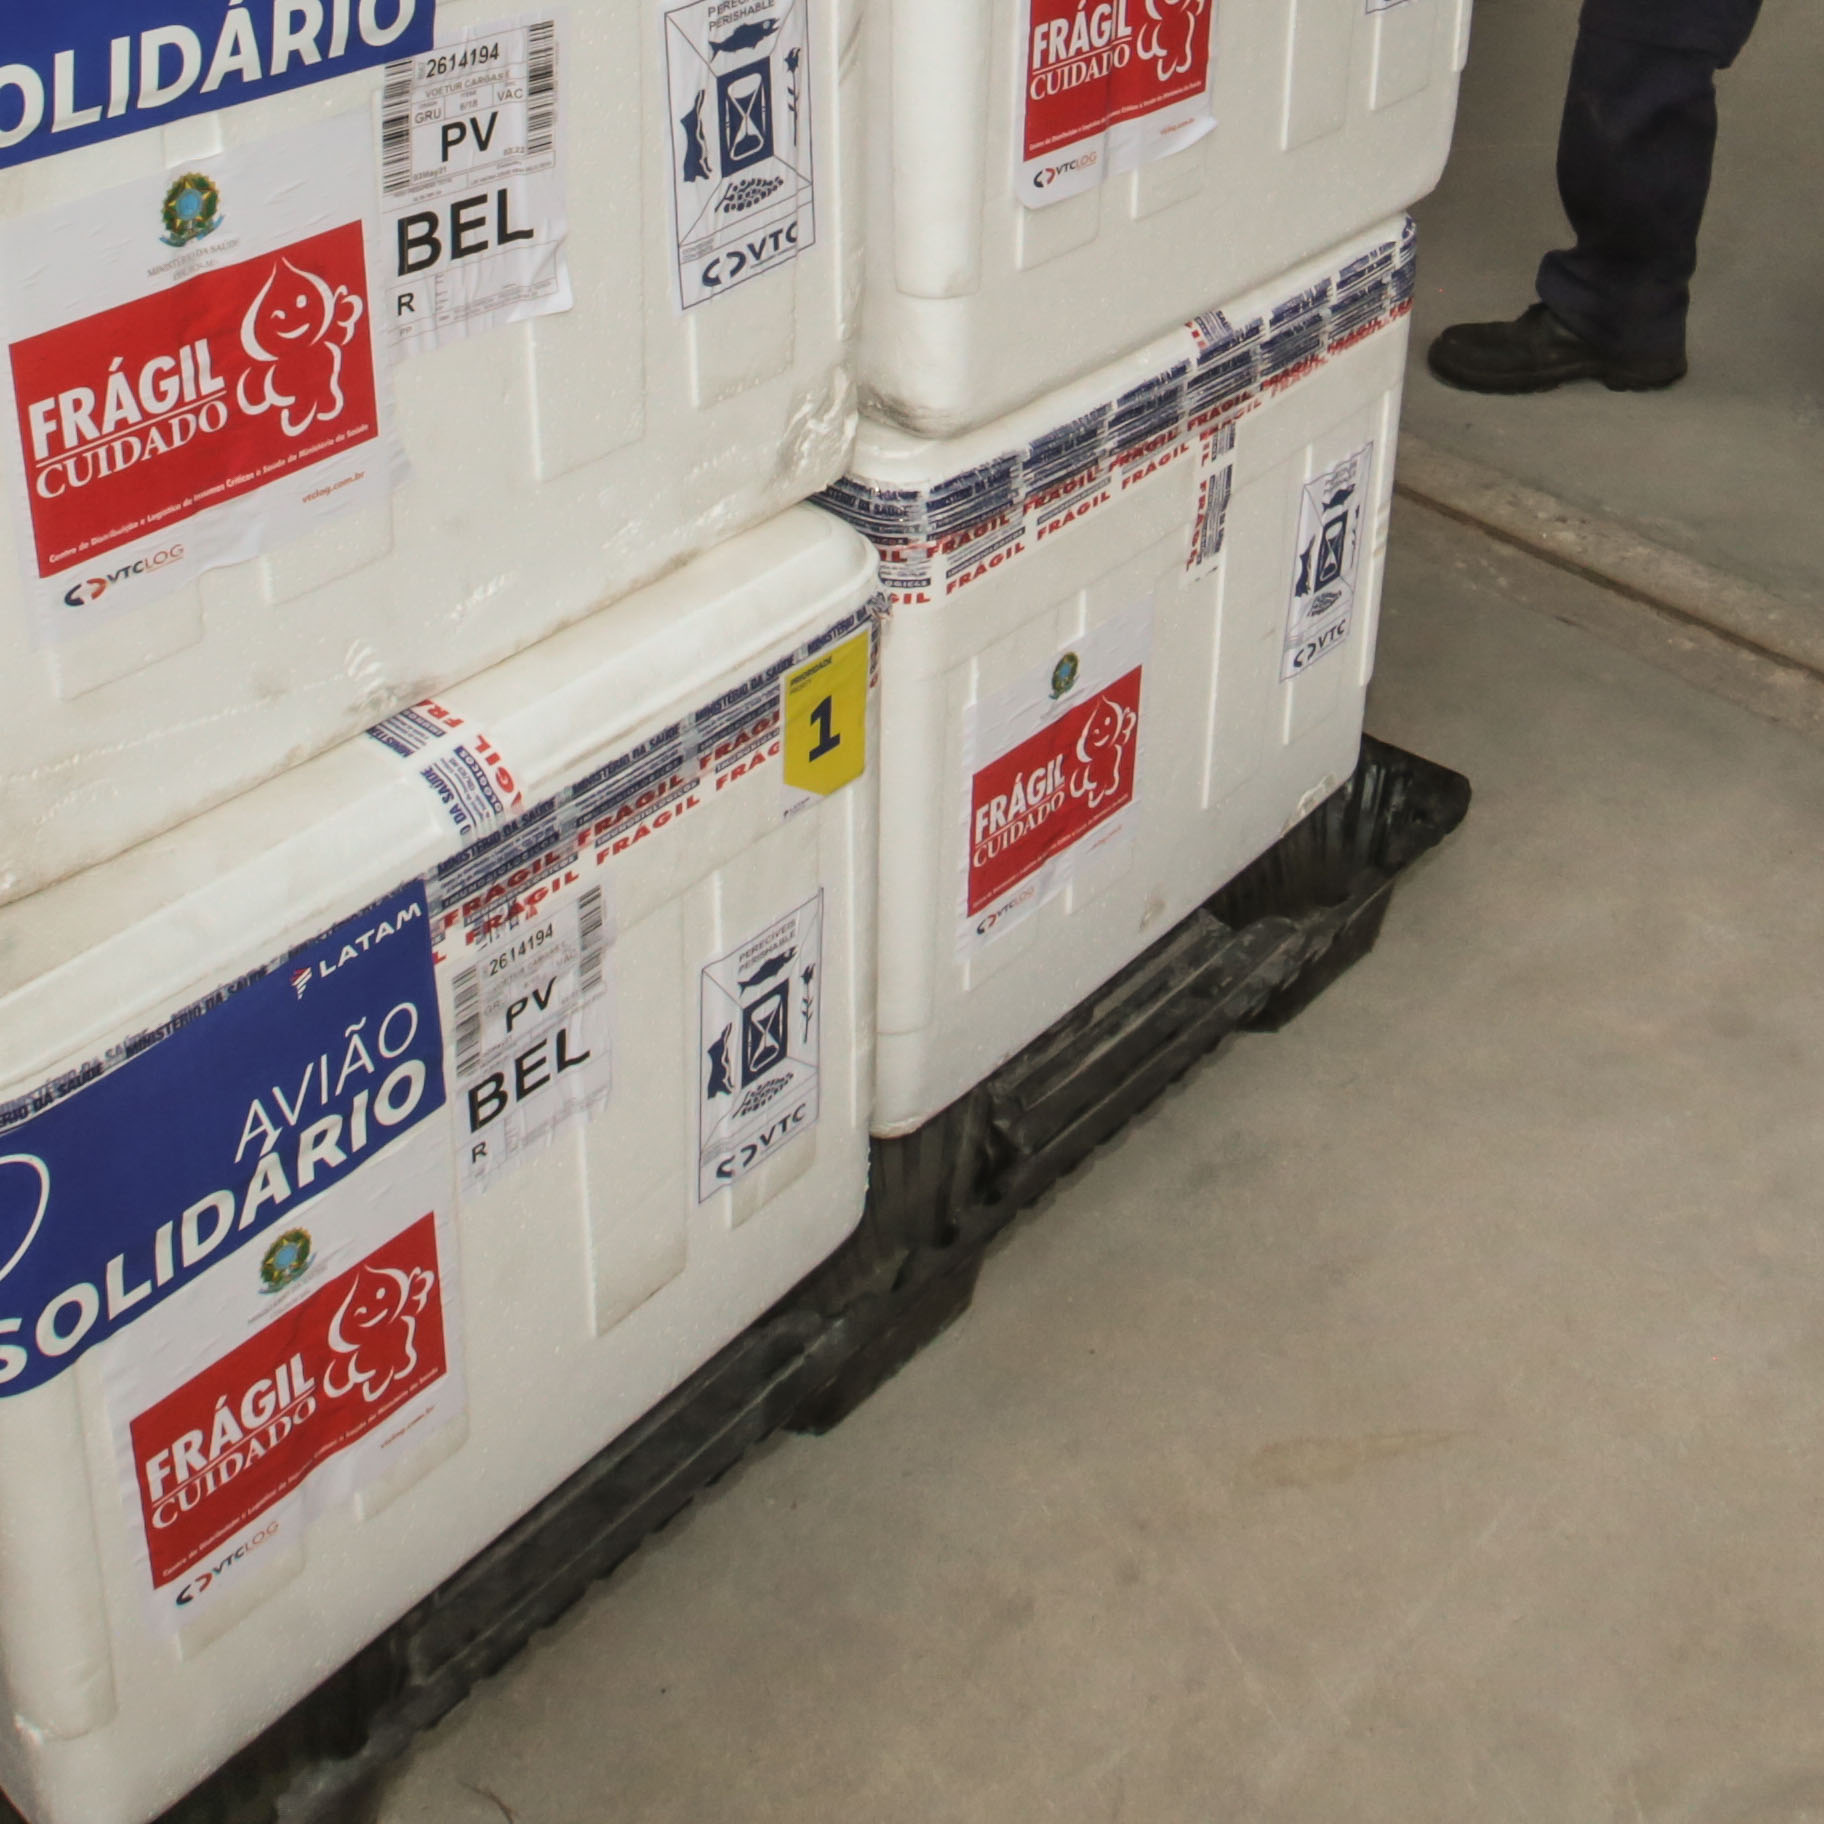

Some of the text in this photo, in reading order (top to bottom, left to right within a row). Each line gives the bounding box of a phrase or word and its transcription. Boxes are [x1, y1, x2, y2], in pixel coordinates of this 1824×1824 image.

[426, 42, 501, 78] 2614194
[1030, 42, 1131, 101] CUIDADO
[415, 88, 523, 125] GRU VAC
[441, 111, 499, 162] PV
[397, 188, 534, 277] BEL
[747, 221, 798, 262] VTC
[397, 292, 415, 316] R
[28, 338, 226, 462] FRÁGIL
[36, 400, 228, 500] CUIDADO
[1123, 442, 1189, 490] FRÁGIL
[1037, 491, 1111, 541] FRÁGIL
[108, 543, 184, 584] VTCLOG
[946, 542, 1025, 596] FRÁGIL
[1319, 618, 1347, 651] VTC
[809, 694, 840, 764] 1
[975, 754, 1065, 843] FRÁGIL
[597, 795, 702, 867] FRÁGIL
[972, 791, 1065, 868] CUIDADO
[316, 901, 423, 979] LATAM
[489, 922, 553, 977] 2614194
[506, 975, 557, 1034] PV
[234, 1002, 419, 1164] AVIÃO
[469, 1028, 591, 1133] BEL
[471, 1141, 489, 1165] R
[759, 1102, 807, 1149] VTC
[145, 1352, 316, 1503] FRÁGIL
[152, 1395, 317, 1530] CUIDADO
